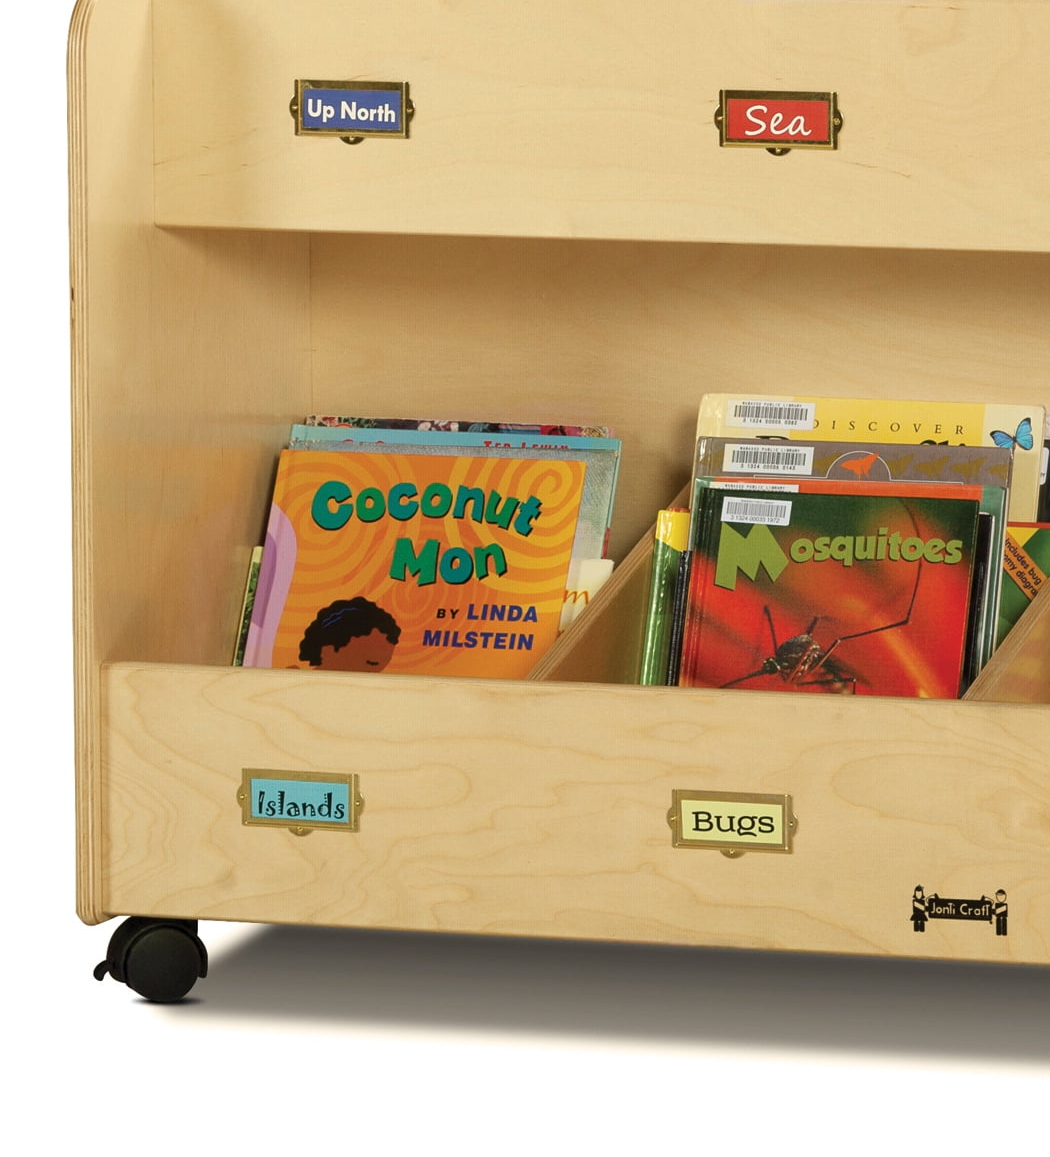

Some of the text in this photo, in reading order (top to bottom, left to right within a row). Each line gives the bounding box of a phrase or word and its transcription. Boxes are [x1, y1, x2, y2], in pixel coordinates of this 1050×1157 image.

[307, 98, 396, 123] Up North
[744, 104, 812, 136] Sea
[311, 480, 544, 537] Coconut
[389, 537, 508, 587] Mon
[714, 521, 963, 591] Mosquitoes
[1028, 566, 1042, 585] bug
[436, 603, 538, 623] BY LINDA
[422, 630, 534, 651] MILSTEIN
[258, 790, 345, 819] Islands
[691, 811, 775, 837] Bugs
